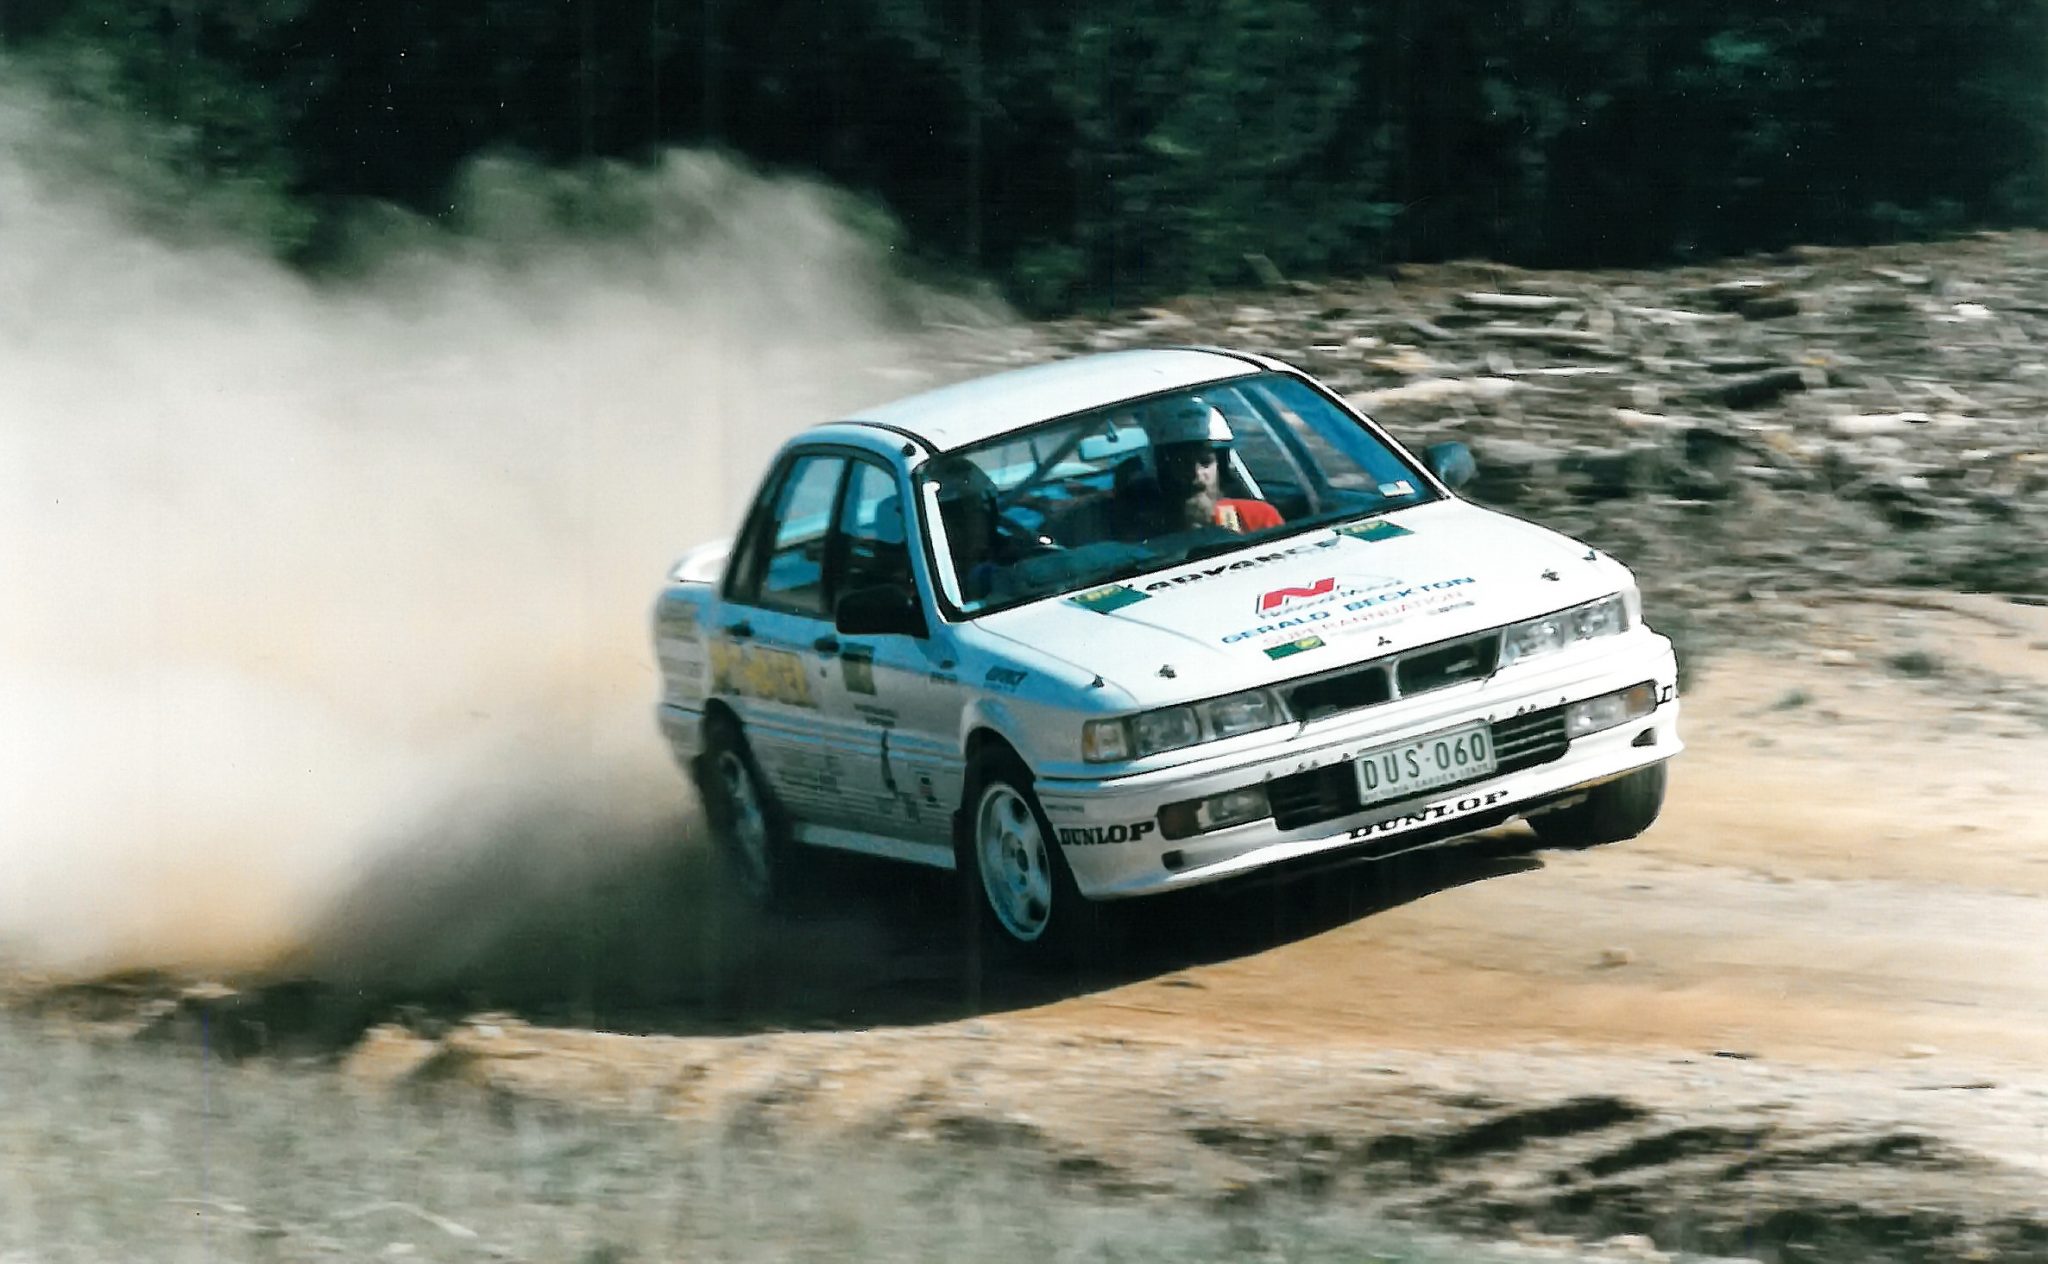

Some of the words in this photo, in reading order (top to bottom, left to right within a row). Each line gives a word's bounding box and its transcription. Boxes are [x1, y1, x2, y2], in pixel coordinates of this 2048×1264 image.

[1221, 610, 1331, 645] GERALD
[1343, 576, 1477, 612] BECKTON
[1058, 820, 1155, 846] DUNLOP
[1348, 790, 1509, 840] DUNLOP
